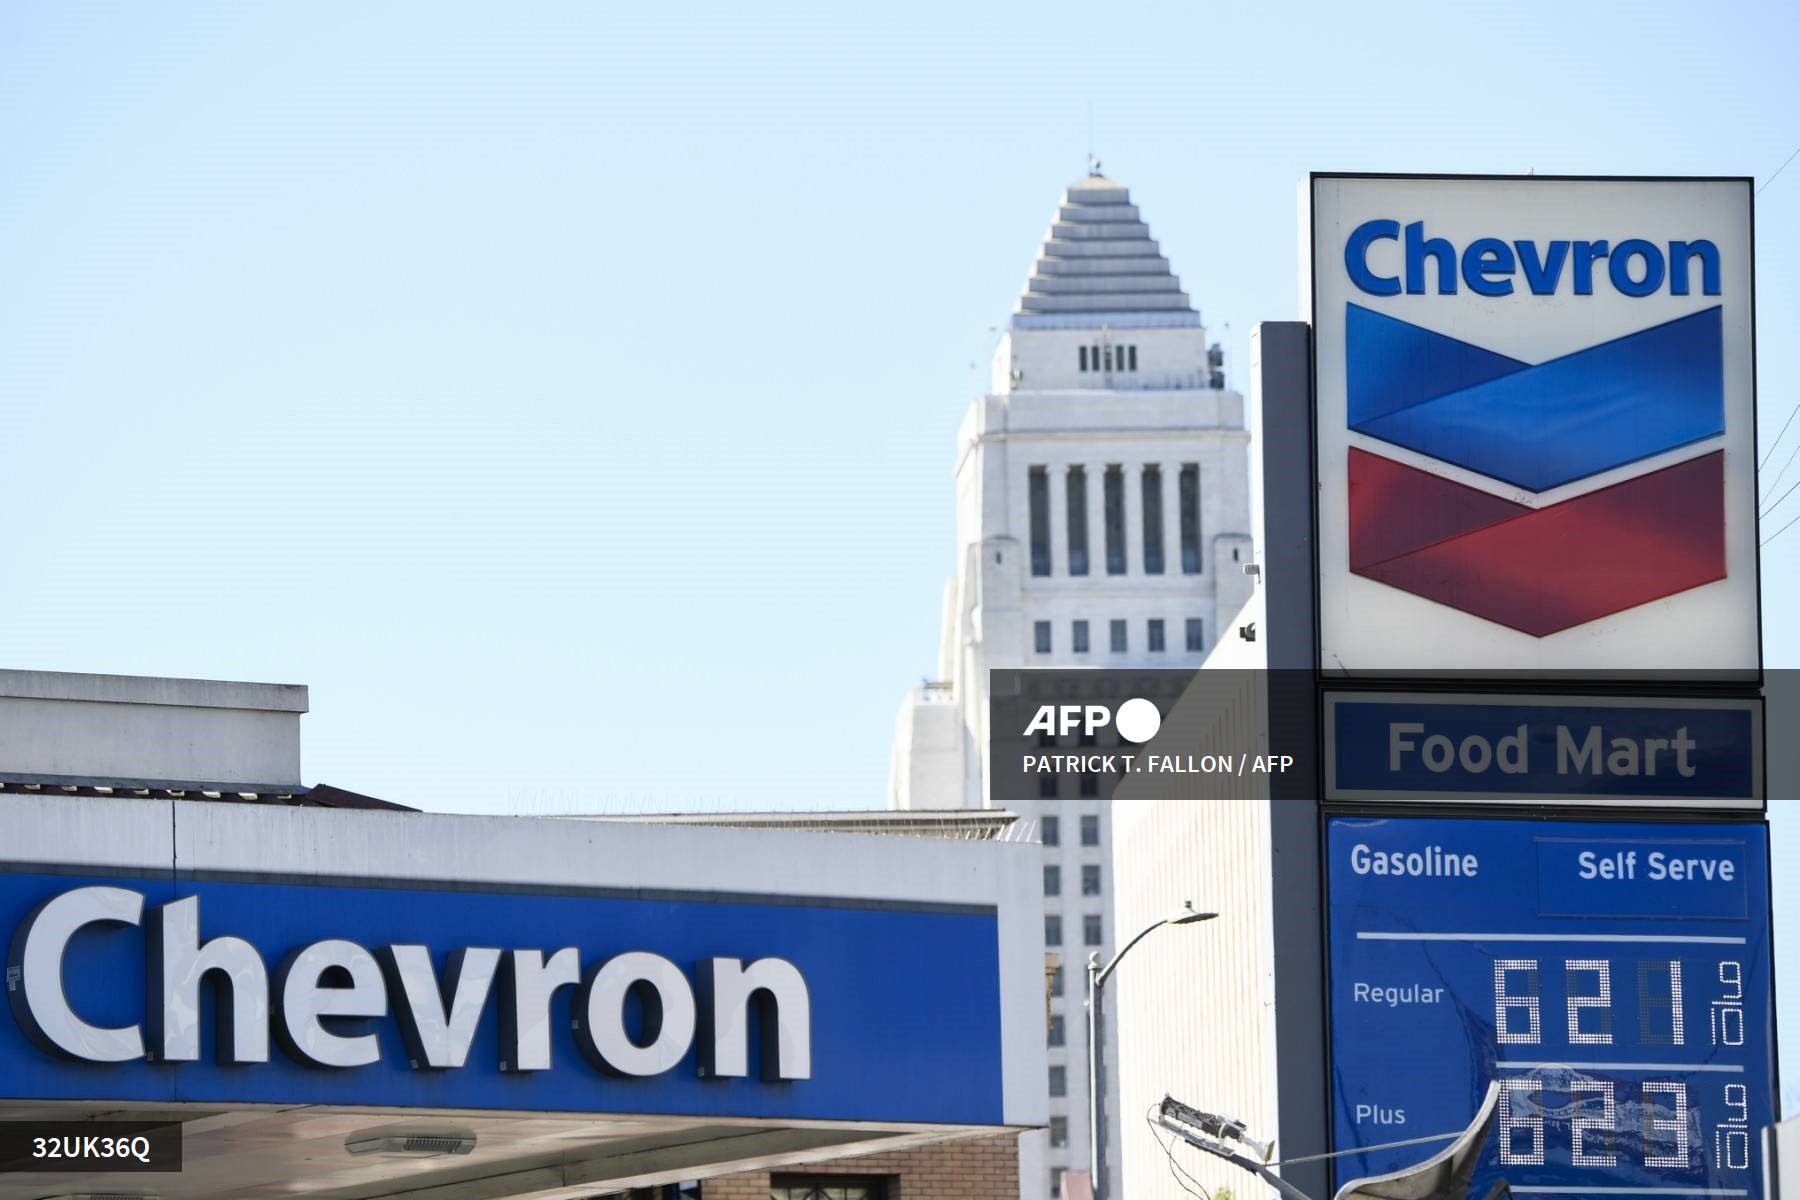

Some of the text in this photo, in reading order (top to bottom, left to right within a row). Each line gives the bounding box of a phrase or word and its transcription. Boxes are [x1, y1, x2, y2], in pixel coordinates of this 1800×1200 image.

[1345, 219, 1722, 298] Chevron
[1389, 722, 1697, 777] Food Mart
[1351, 844, 1479, 877] Gasoline
[1578, 851, 1735, 882] Self Serve
[14, 885, 812, 1080] Chevron
[1354, 983, 1444, 1007] Regular
[1356, 1105, 1406, 1125] Plus
[1499, 1079, 1689, 1168] 623
